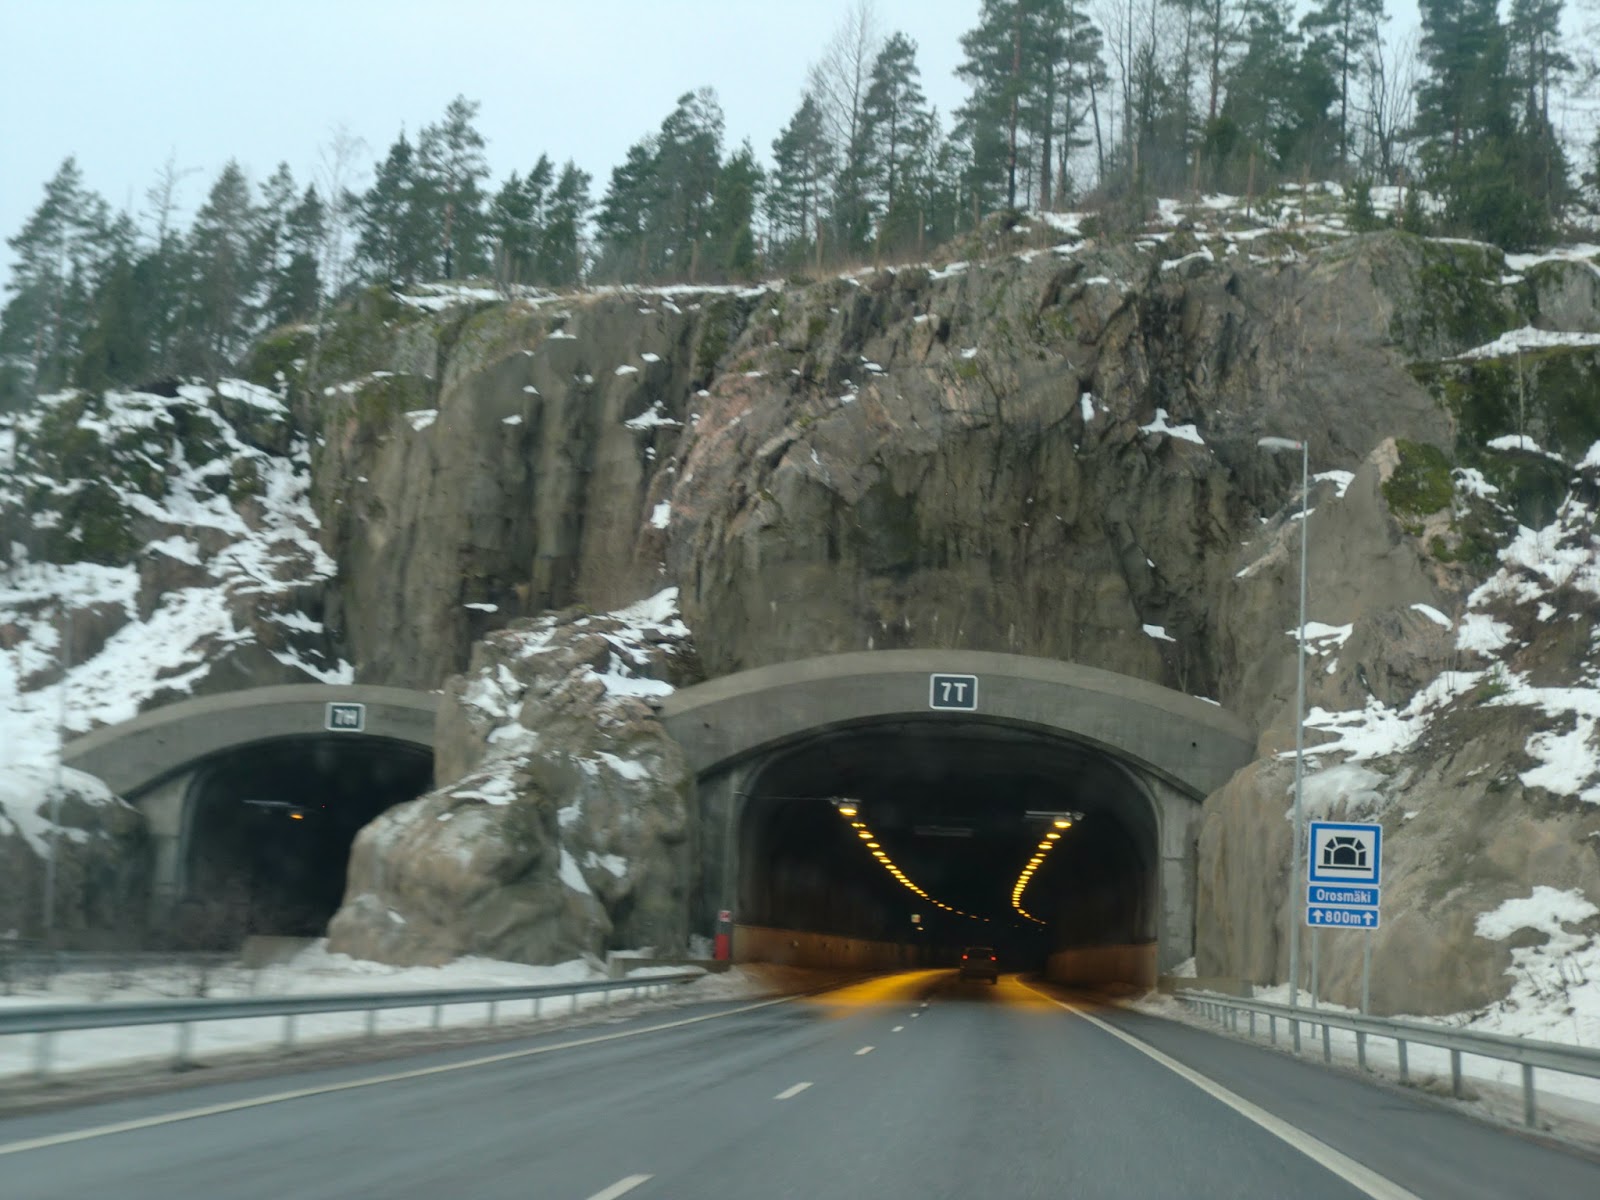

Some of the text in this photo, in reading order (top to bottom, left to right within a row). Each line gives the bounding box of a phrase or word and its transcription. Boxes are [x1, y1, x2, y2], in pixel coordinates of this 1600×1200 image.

[941, 682, 968, 702] 7T
[1316, 889, 1371, 903] Orosmäki
[1325, 910, 1361, 924] 800m
